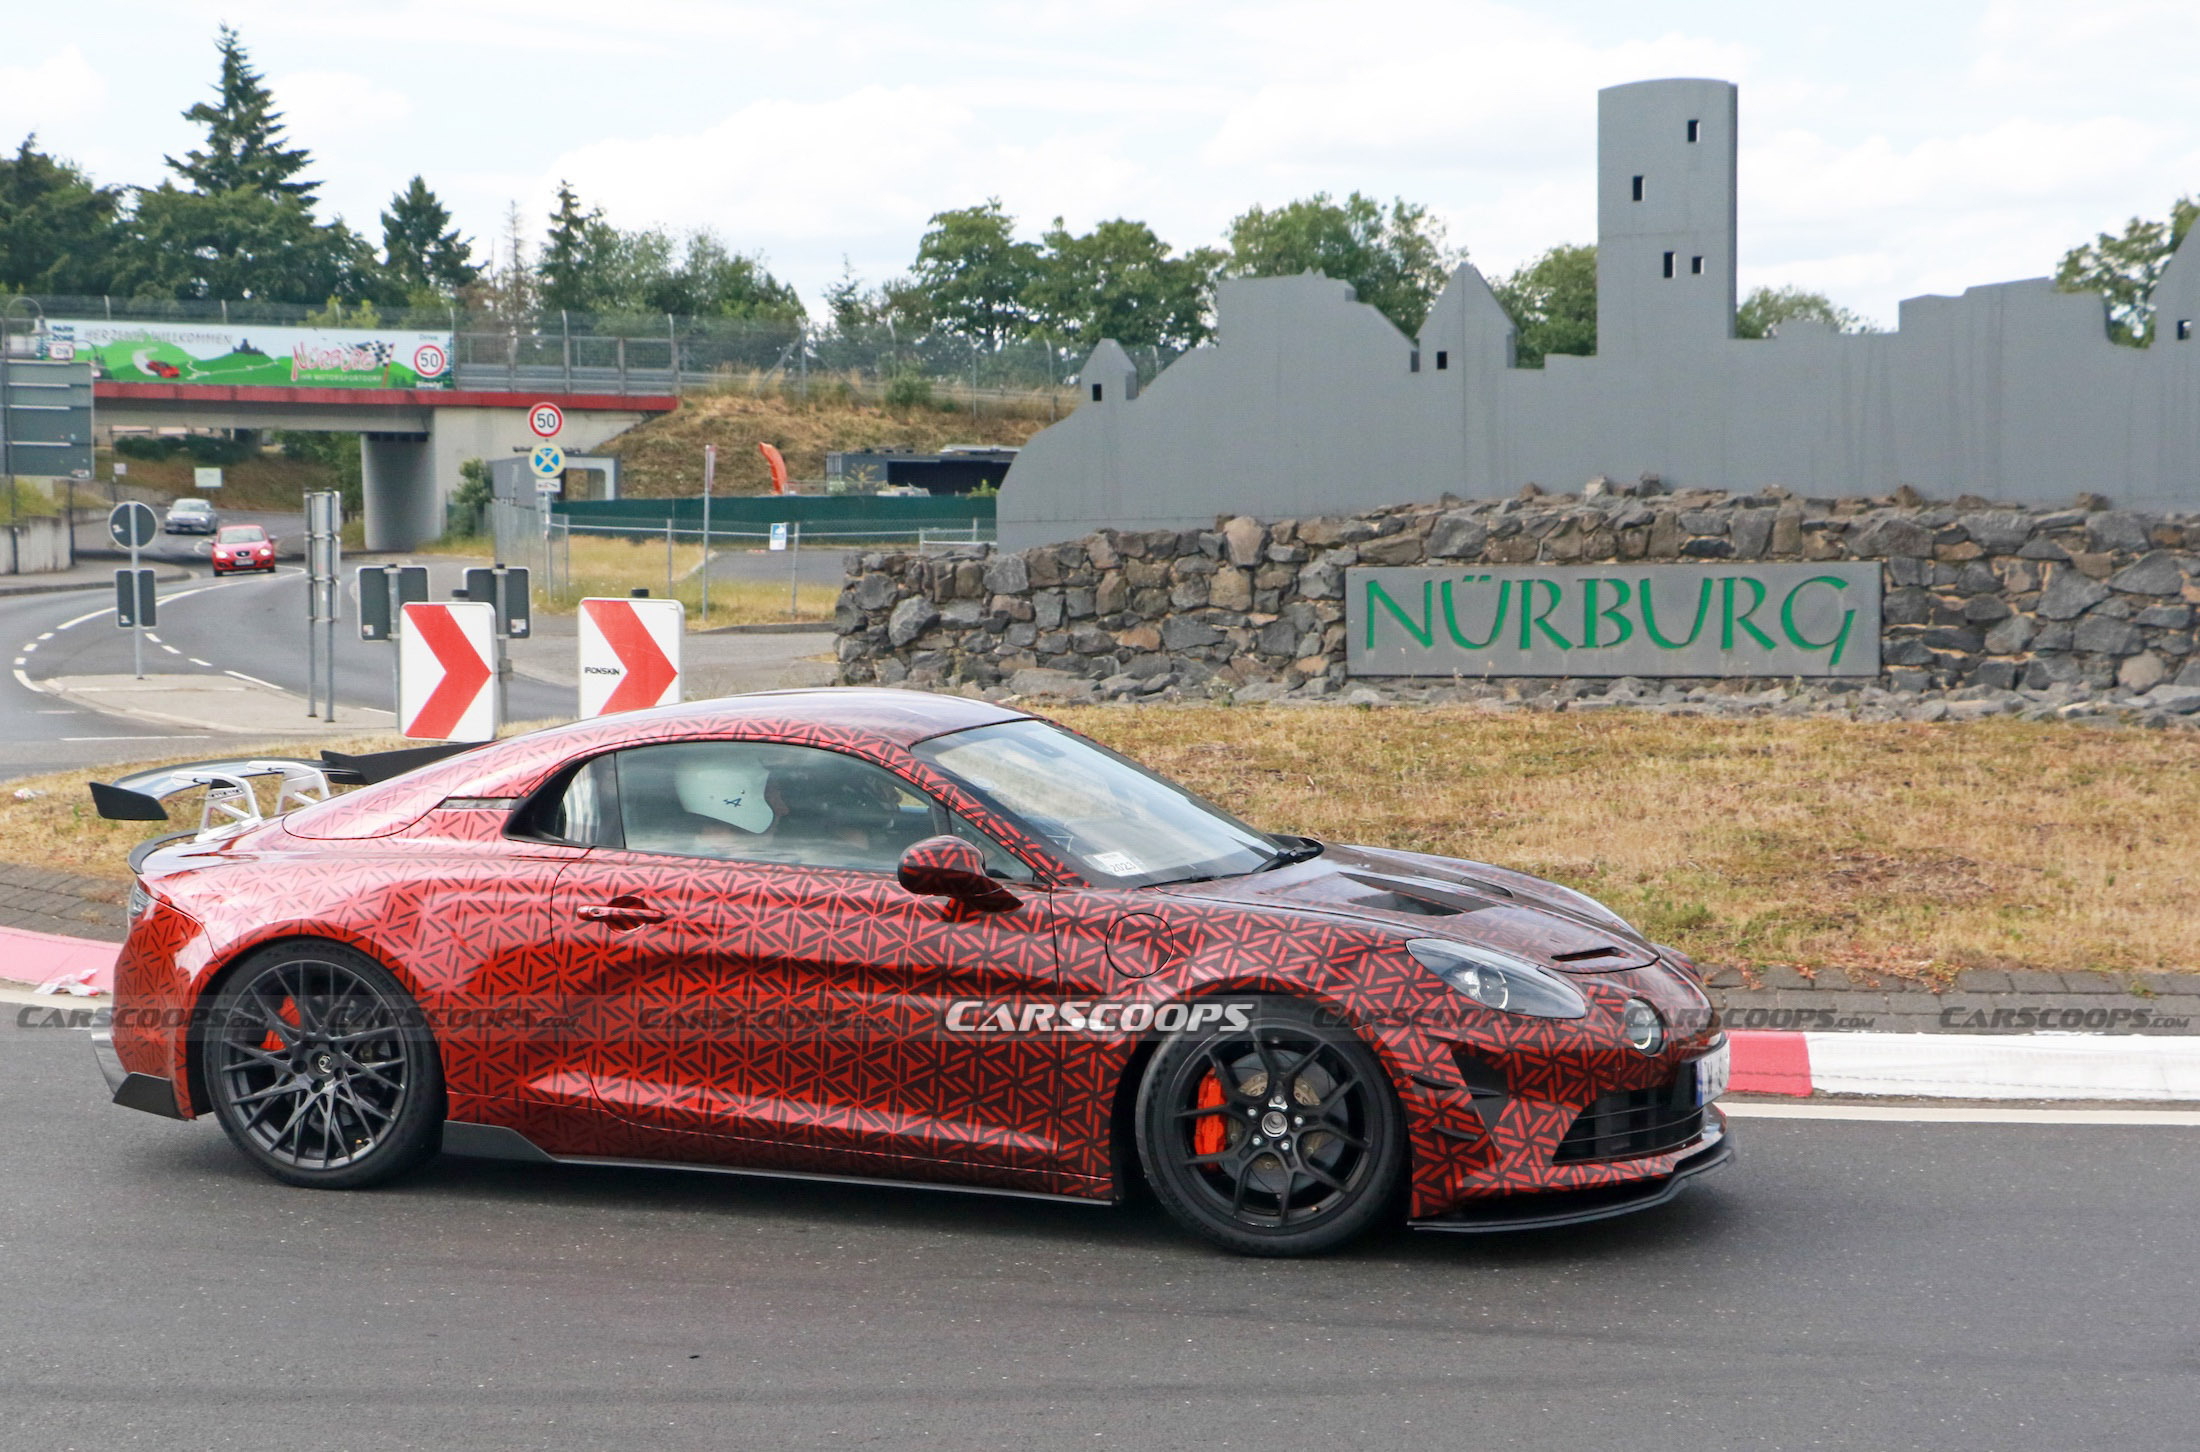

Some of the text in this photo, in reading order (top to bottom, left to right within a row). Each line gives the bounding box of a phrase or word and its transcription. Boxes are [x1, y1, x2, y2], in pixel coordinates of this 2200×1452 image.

[150, 330, 233, 345] WILLKOMMEN
[420, 352, 439, 368] 50
[537, 413, 556, 428] 50
[1366, 575, 1855, 665] NÜRBURG
[1109, 862, 1137, 873] 2023
